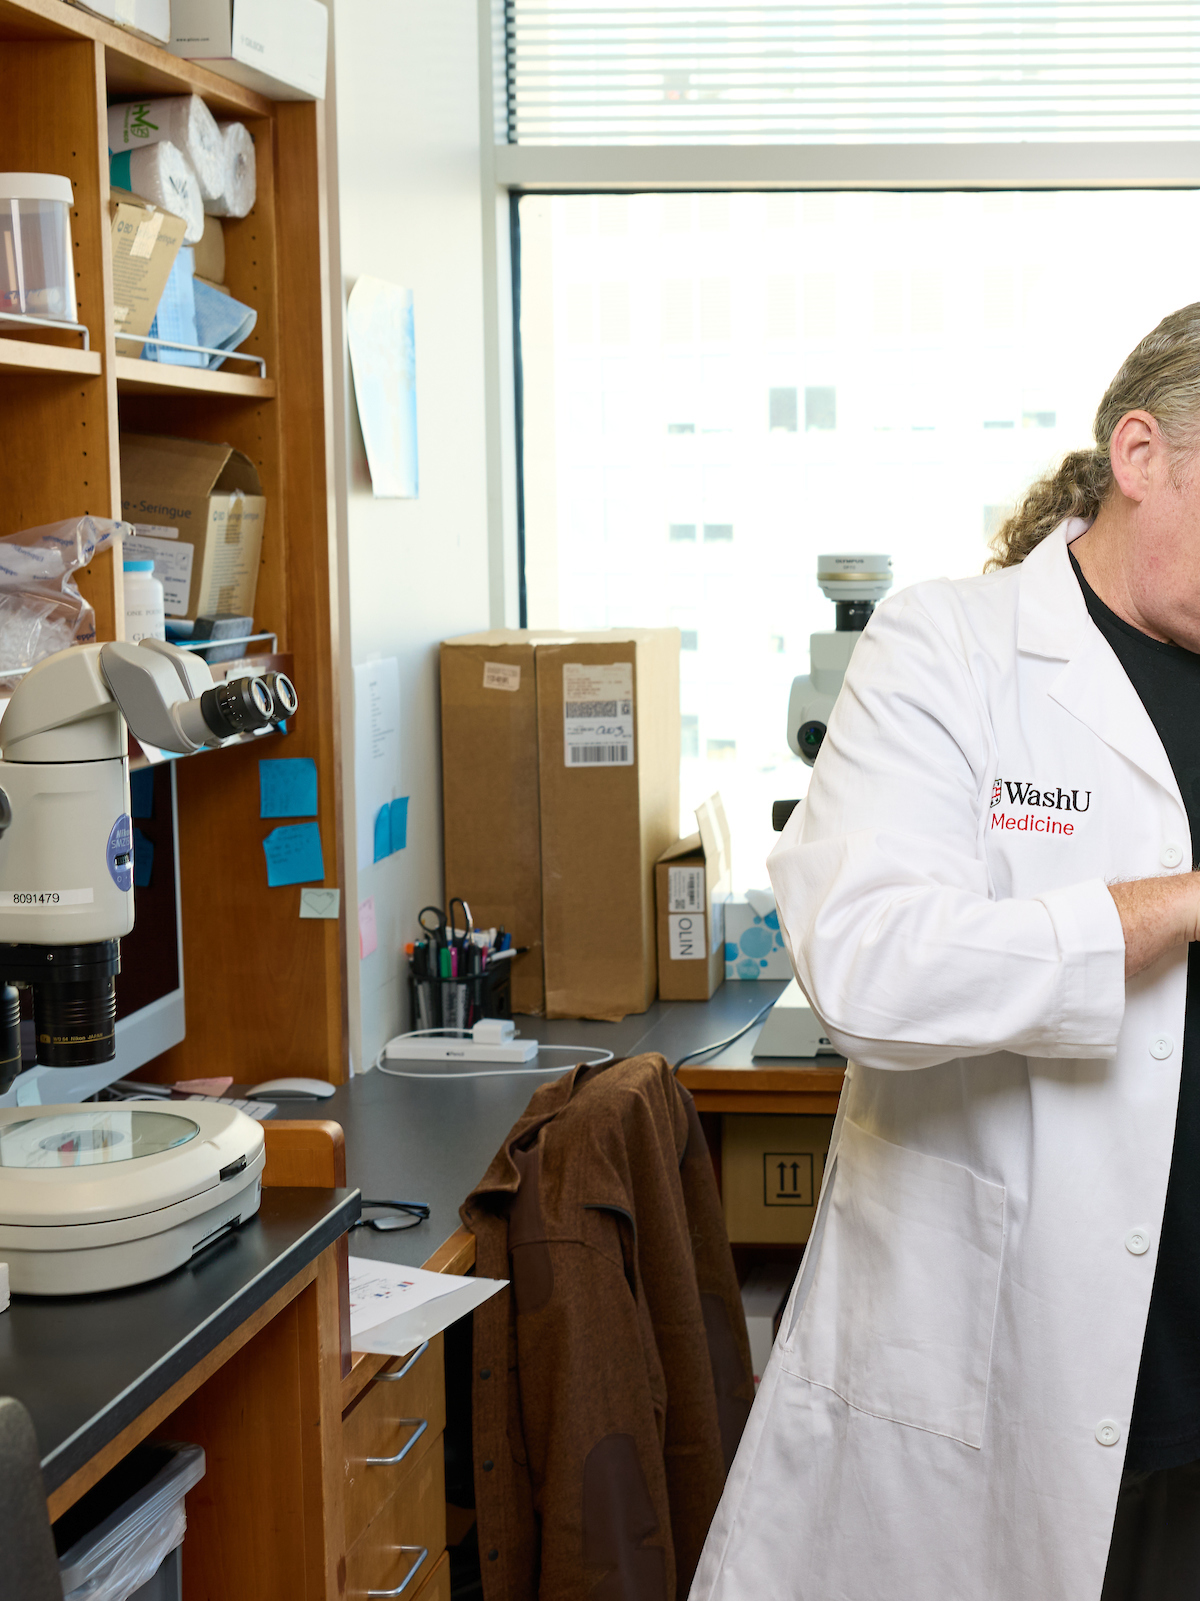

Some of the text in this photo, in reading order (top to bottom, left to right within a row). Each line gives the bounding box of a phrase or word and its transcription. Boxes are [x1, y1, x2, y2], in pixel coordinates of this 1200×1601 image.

[140, 500, 192, 519] Seringue
[1004, 781, 1092, 812] WashU
[991, 813, 1074, 836] Medicine
[13, 893, 60, 904] 8091479
[678, 917, 694, 956] OLIN
[87, 1032, 104, 1040] JAPAN
